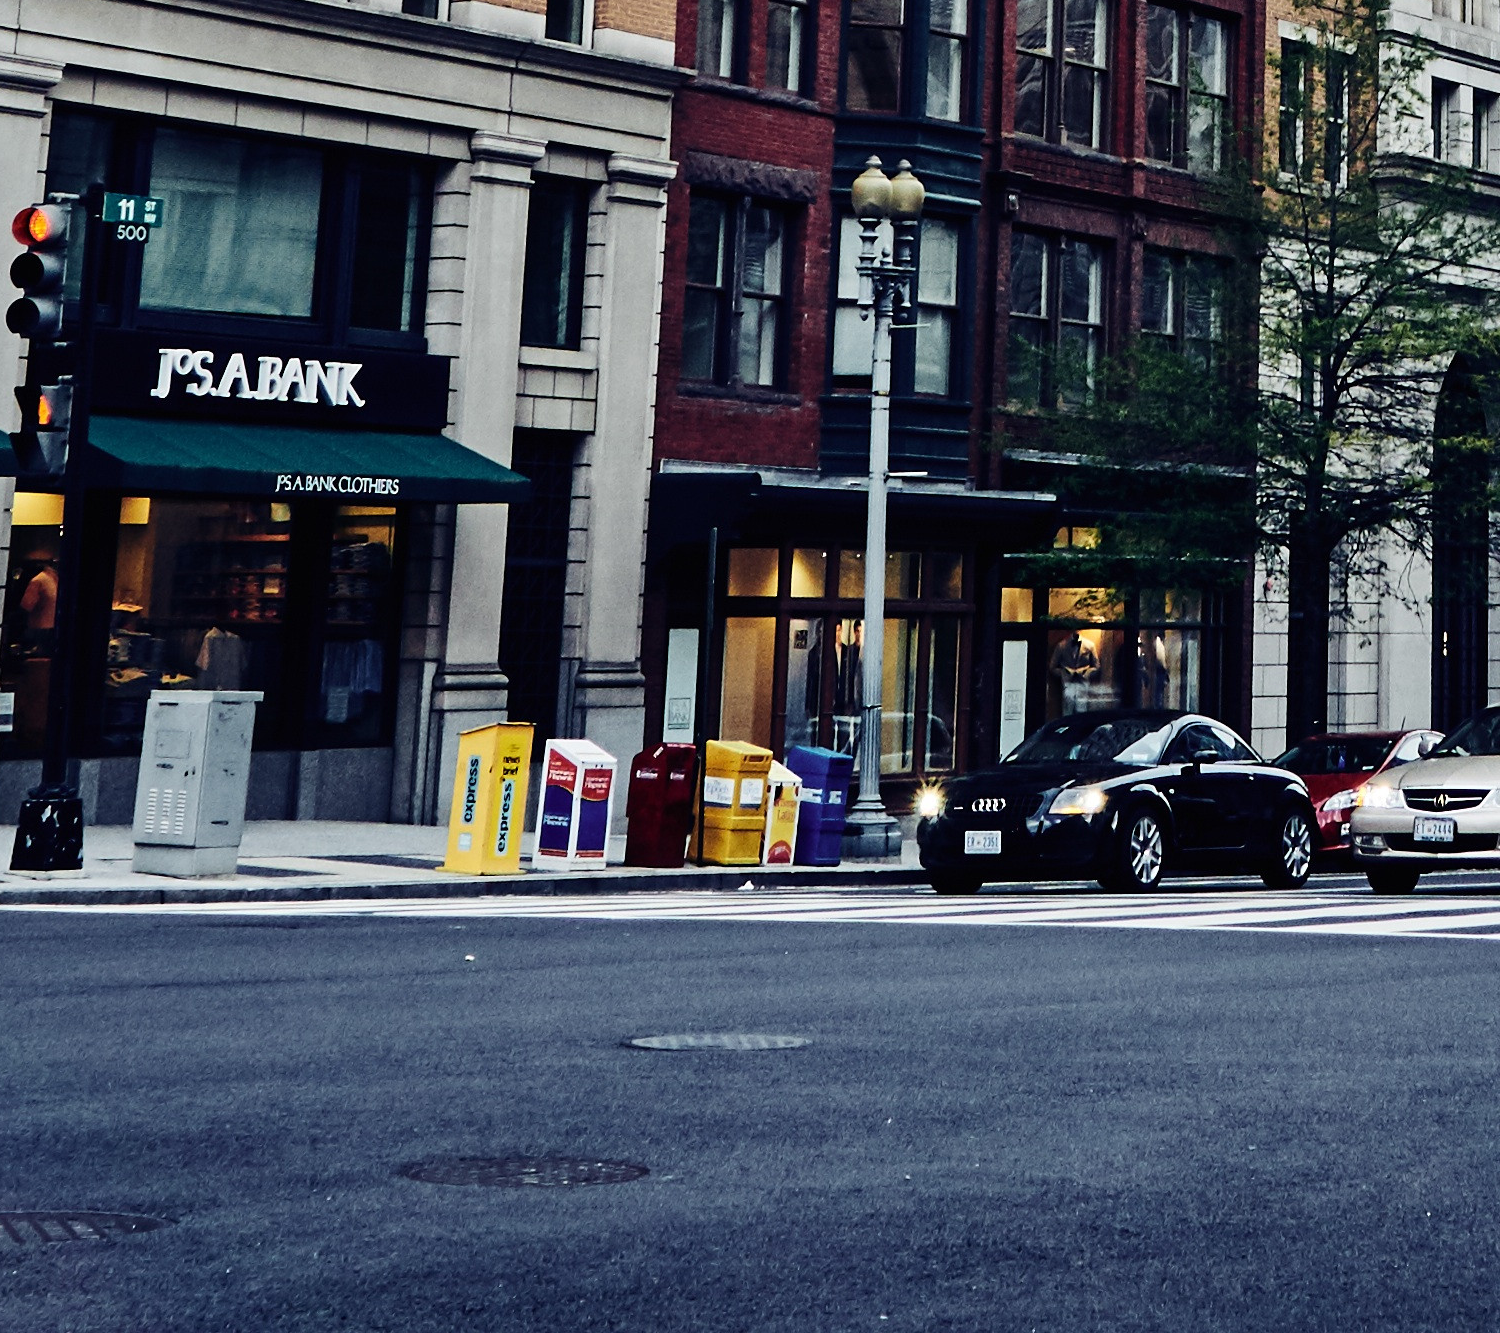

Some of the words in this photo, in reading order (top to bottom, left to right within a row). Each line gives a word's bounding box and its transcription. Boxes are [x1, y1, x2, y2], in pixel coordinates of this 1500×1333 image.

[117, 198, 135, 221] 11
[144, 200, 157, 212] ST
[116, 224, 147, 241] 500
[305, 475, 338, 492] BANK
[338, 475, 400, 495] CLOTHIERS
[463, 757, 480, 823] express
[497, 782, 513, 853] express
